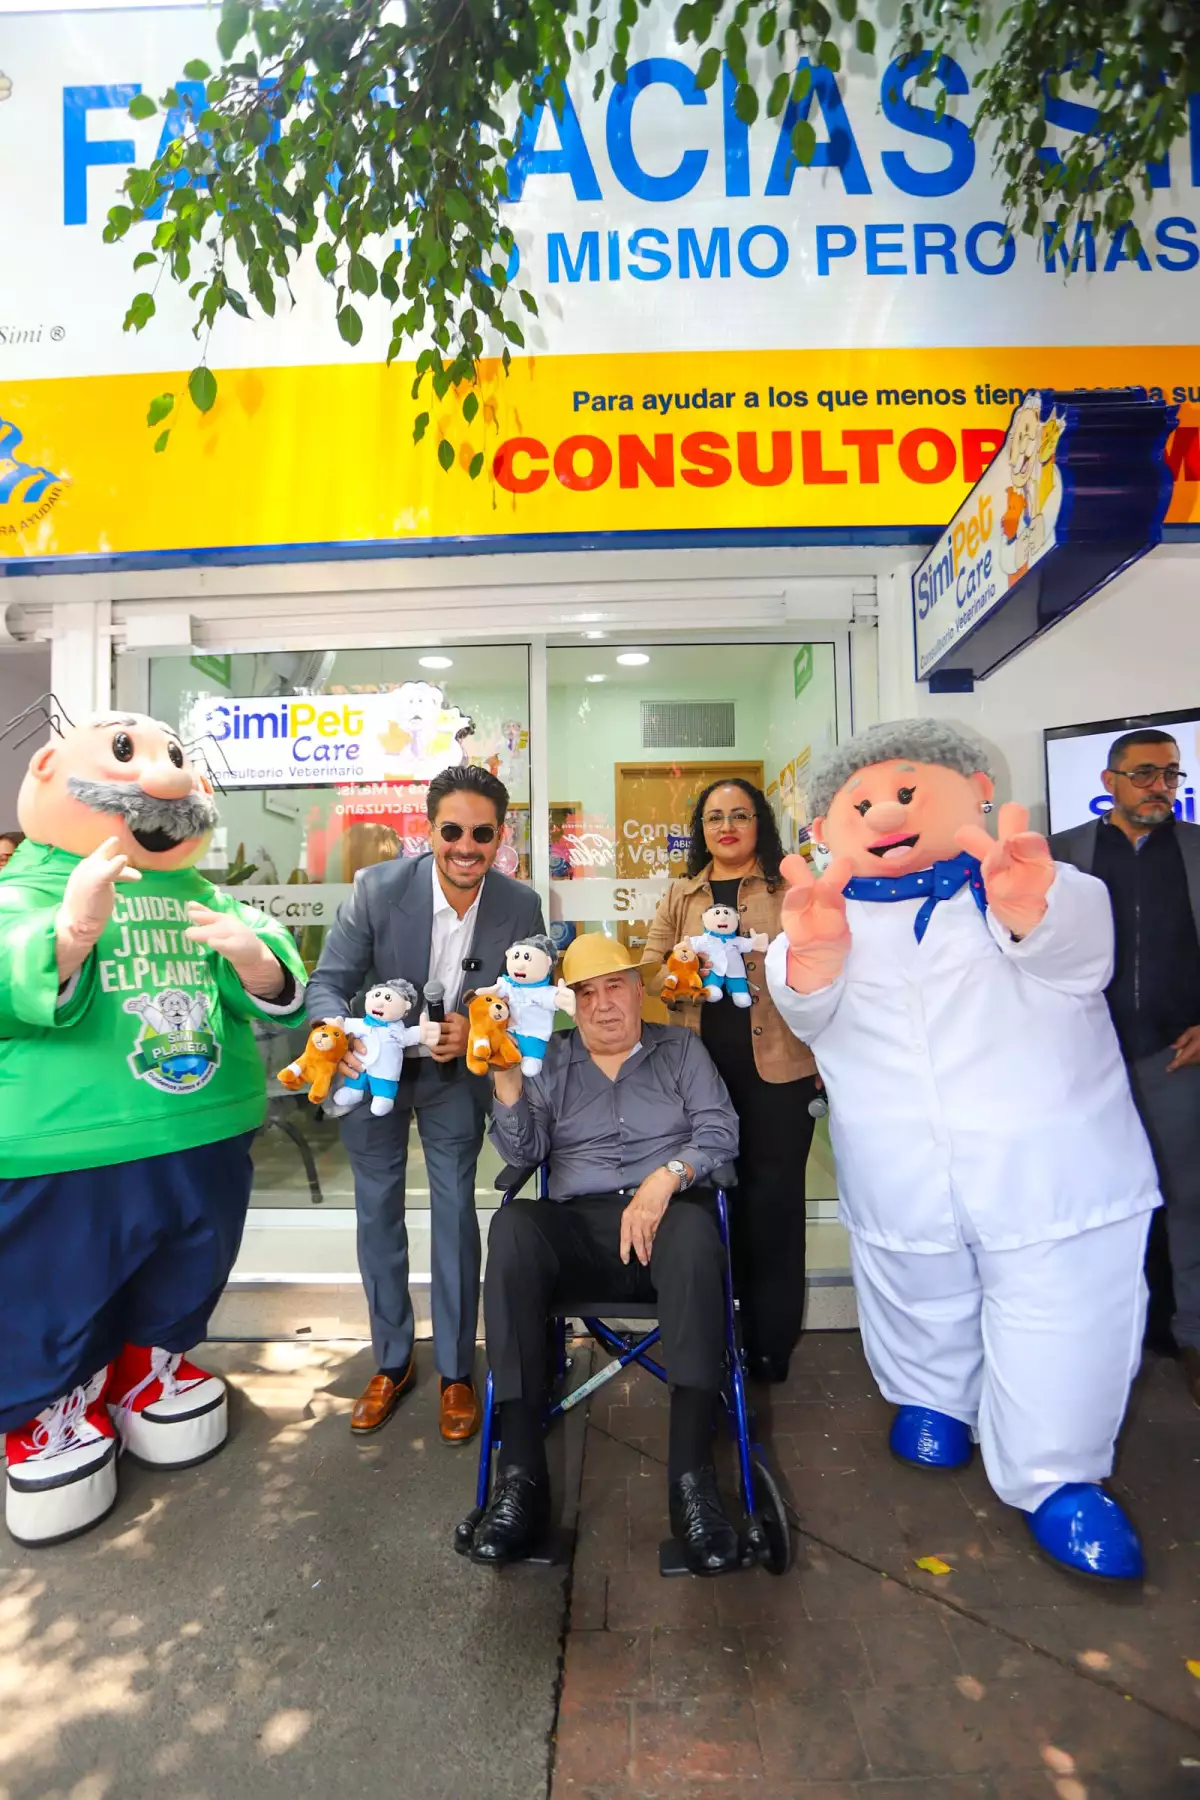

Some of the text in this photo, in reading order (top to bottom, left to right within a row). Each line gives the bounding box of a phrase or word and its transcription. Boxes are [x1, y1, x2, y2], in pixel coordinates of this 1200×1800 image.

[547, 224, 790, 284] MISMO
[816, 221, 1016, 277] PERO
[1043, 216, 1200, 274] MAS
[573, 391, 634, 412] Para
[642, 388, 736, 415] ayudar
[744, 391, 760, 408] a
[769, 386, 809, 407] los
[817, 389, 868, 412] que
[876, 387, 967, 406] menos
[918, 494, 993, 620] SimiPet
[955, 549, 993, 609] Care
[955, 583, 996, 632] Veterinario
[292, 736, 361, 762] Care
[288, 765, 364, 777] Veterinario
[270, 896, 324, 917] Care
[152, 1042, 208, 1059] PLANETA
